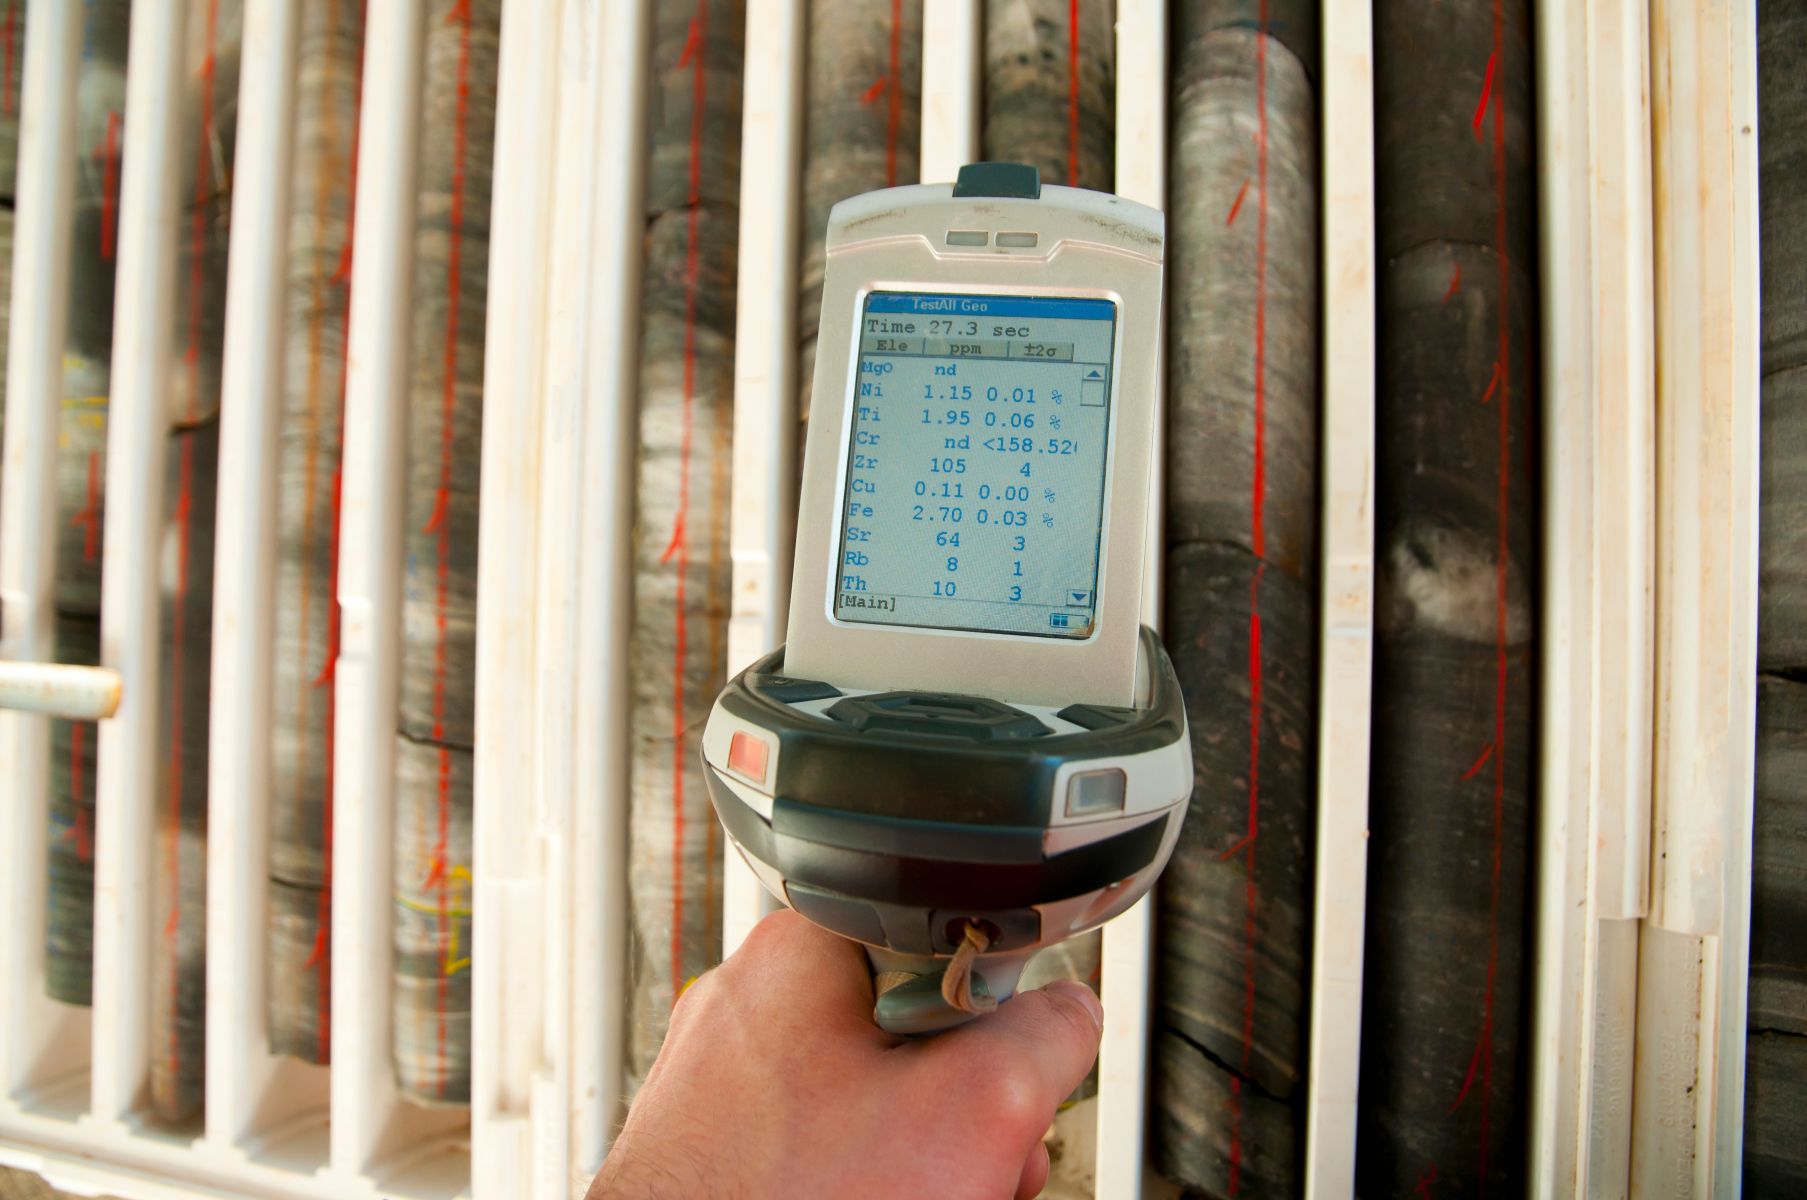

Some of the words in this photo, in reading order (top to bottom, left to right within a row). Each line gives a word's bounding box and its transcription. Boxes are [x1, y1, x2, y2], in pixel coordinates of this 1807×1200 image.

[912, 297, 957, 312] TestAll
[961, 299, 988, 312] Geo
[868, 320, 916, 334] Time
[929, 320, 978, 336] 27.3
[992, 325, 1030, 338] sec
[876, 340, 908, 353] Ele
[950, 343, 982, 356] ppm
[862, 362, 893, 376] MgO
[934, 364, 957, 376] nd
[860, 384, 883, 397] Ni
[923, 384, 972, 400] 1.15
[986, 386, 1036, 403] 0.01
[858, 408, 881, 422] Ti
[921, 410, 971, 425] 1.95
[984, 412, 1035, 428] 0.06
[856, 432, 880, 445] Cr
[944, 435, 970, 450] nd
[854, 455, 878, 468] Zr
[930, 458, 966, 474] 105
[1020, 462, 1030, 478] 4
[852, 480, 876, 493] Cu
[914, 482, 964, 498] 0.11
[978, 486, 1029, 502] 0.00
[848, 503, 874, 517] Fe
[912, 506, 962, 522] 2.70
[977, 510, 1028, 526] 0.03
[847, 528, 872, 542] Sr
[936, 532, 960, 547] 64
[1014, 536, 1026, 552] 3
[844, 552, 868, 566] Rb
[947, 557, 958, 572] 8
[1014, 561, 1022, 576] 1
[843, 576, 866, 591] Th
[933, 580, 956, 596] 10
[1009, 586, 1022, 602] 3
[839, 594, 896, 612] [Main]
